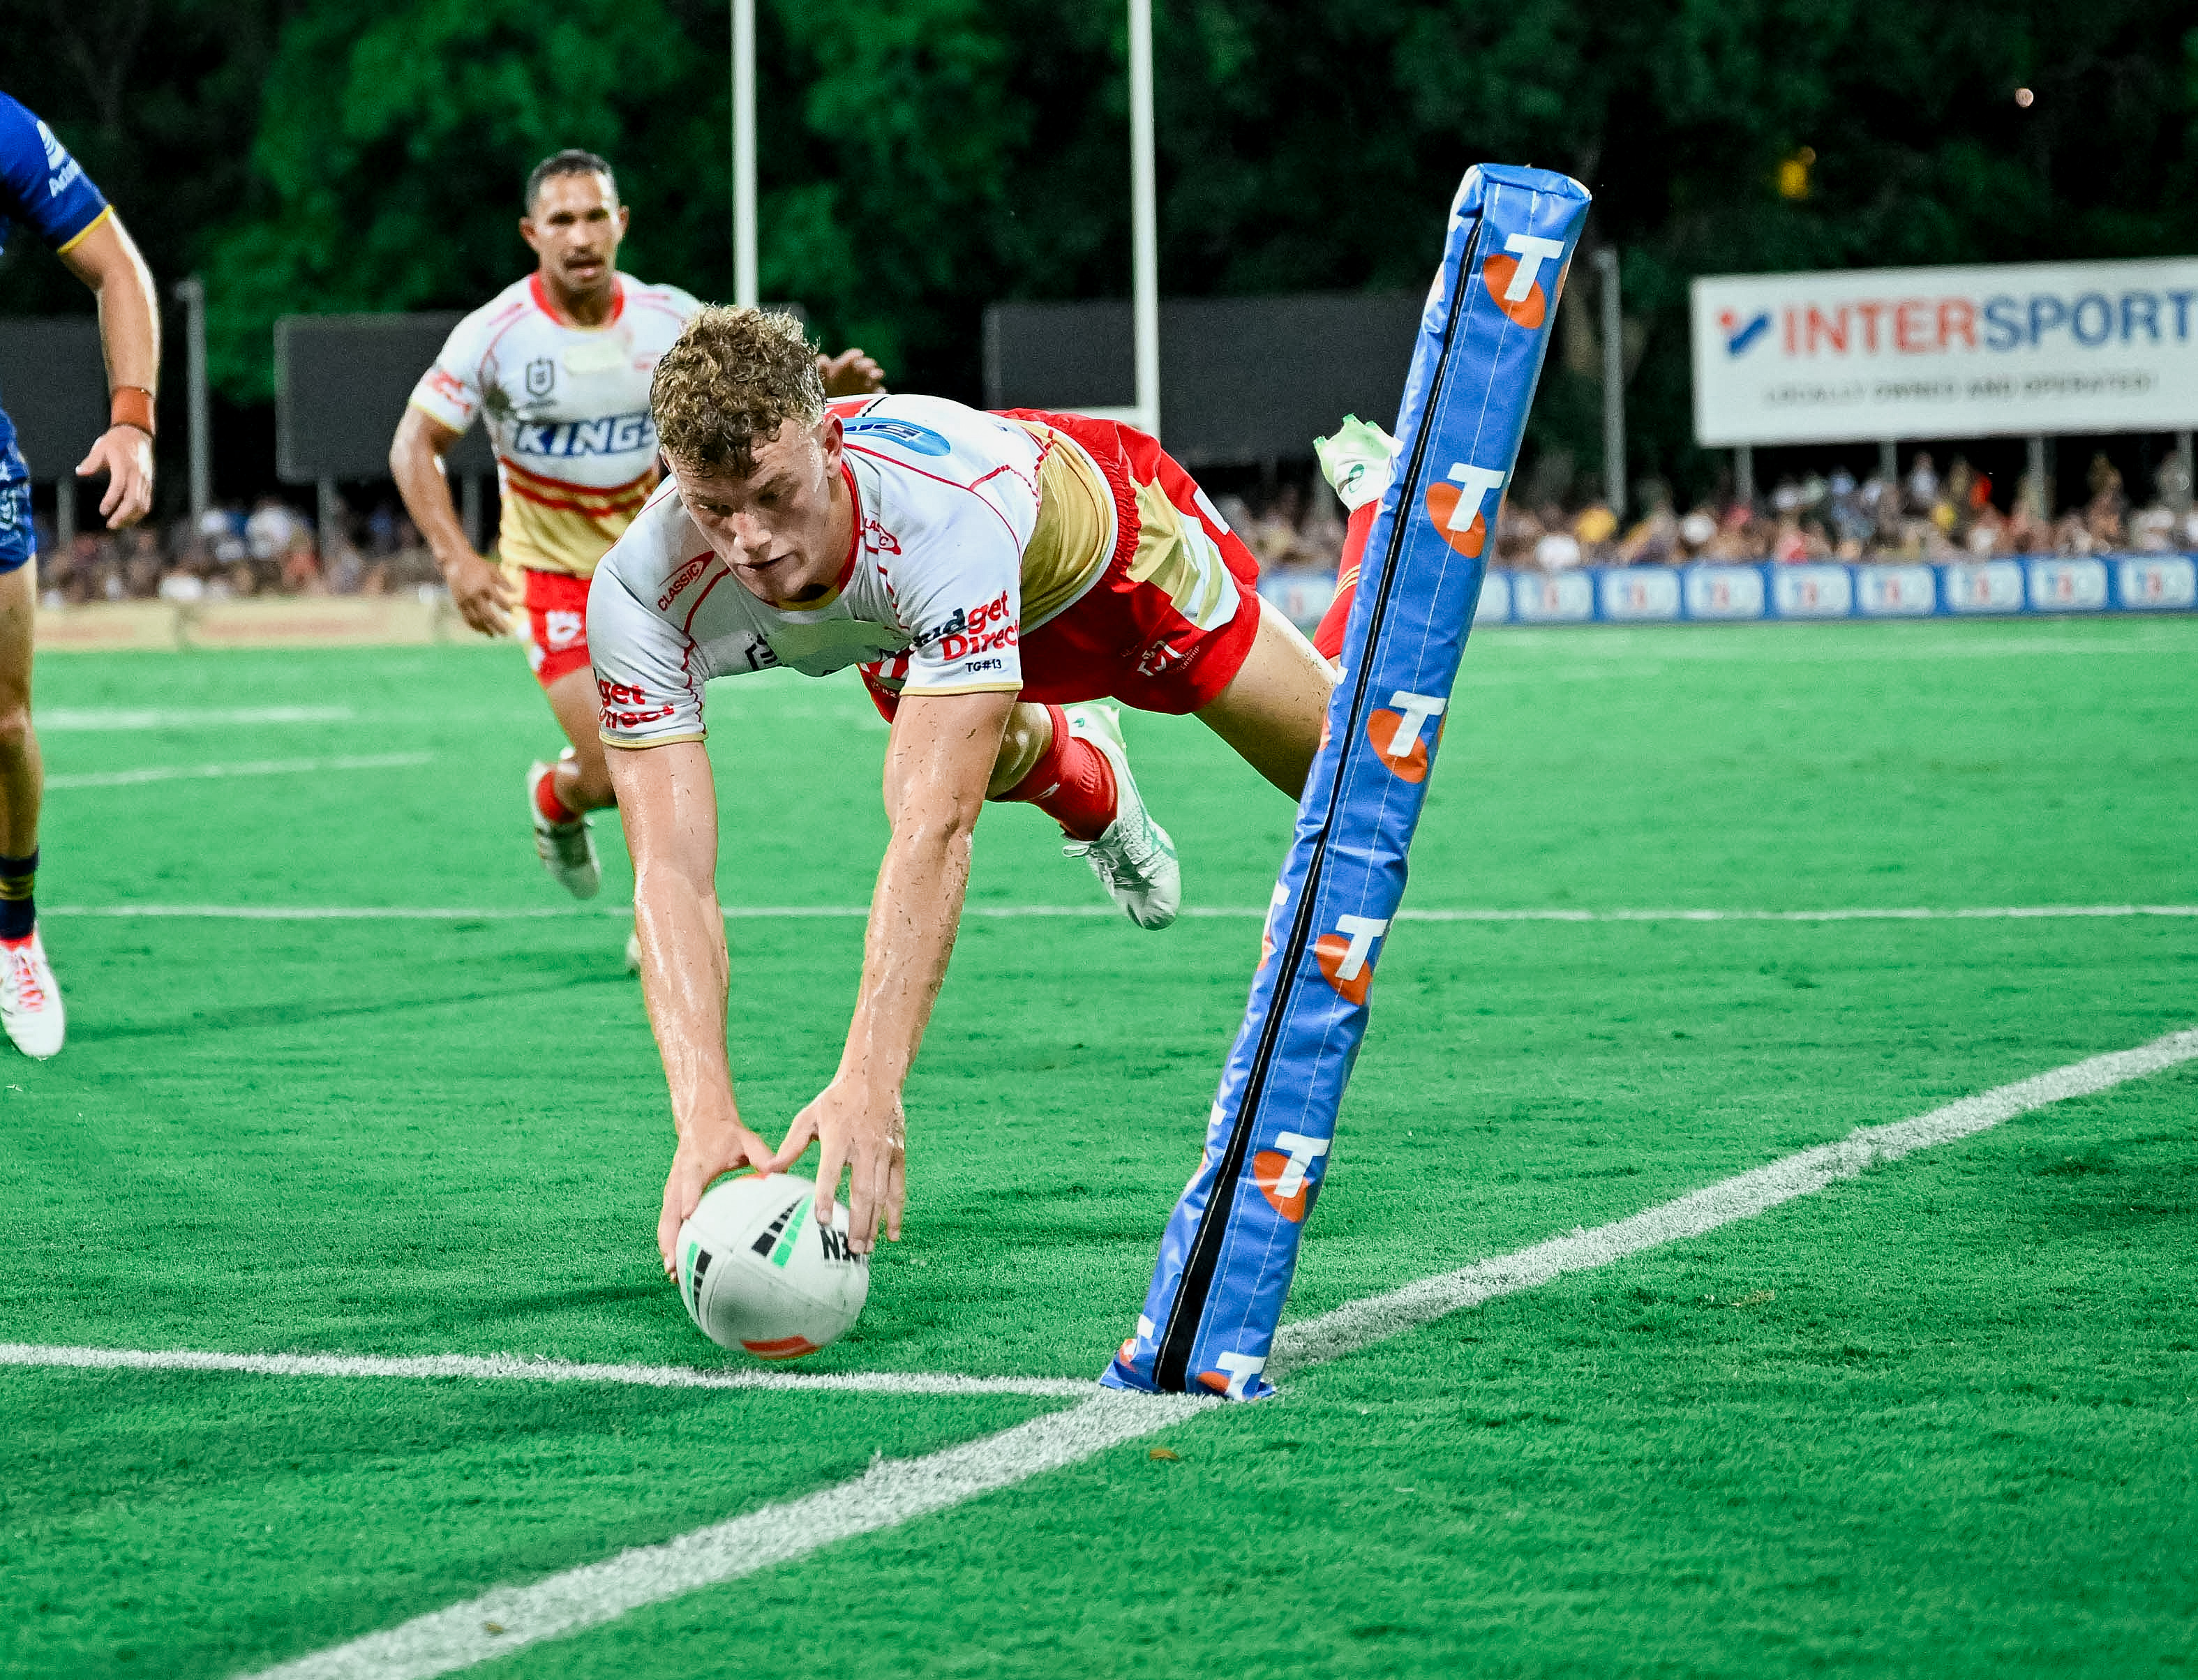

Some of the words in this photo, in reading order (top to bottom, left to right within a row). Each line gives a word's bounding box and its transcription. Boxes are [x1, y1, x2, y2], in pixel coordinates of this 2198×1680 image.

[1504, 232, 1565, 302] T
[1780, 292, 2198, 357] INTERSPORT
[1446, 462, 1507, 532] T
[657, 563, 700, 612] CLASSIC
[599, 678, 646, 707] get
[965, 659, 1002, 673] TG#13
[1386, 690, 1447, 758] T
[1334, 914, 1389, 982] T
[1273, 1131, 1330, 1199] T
